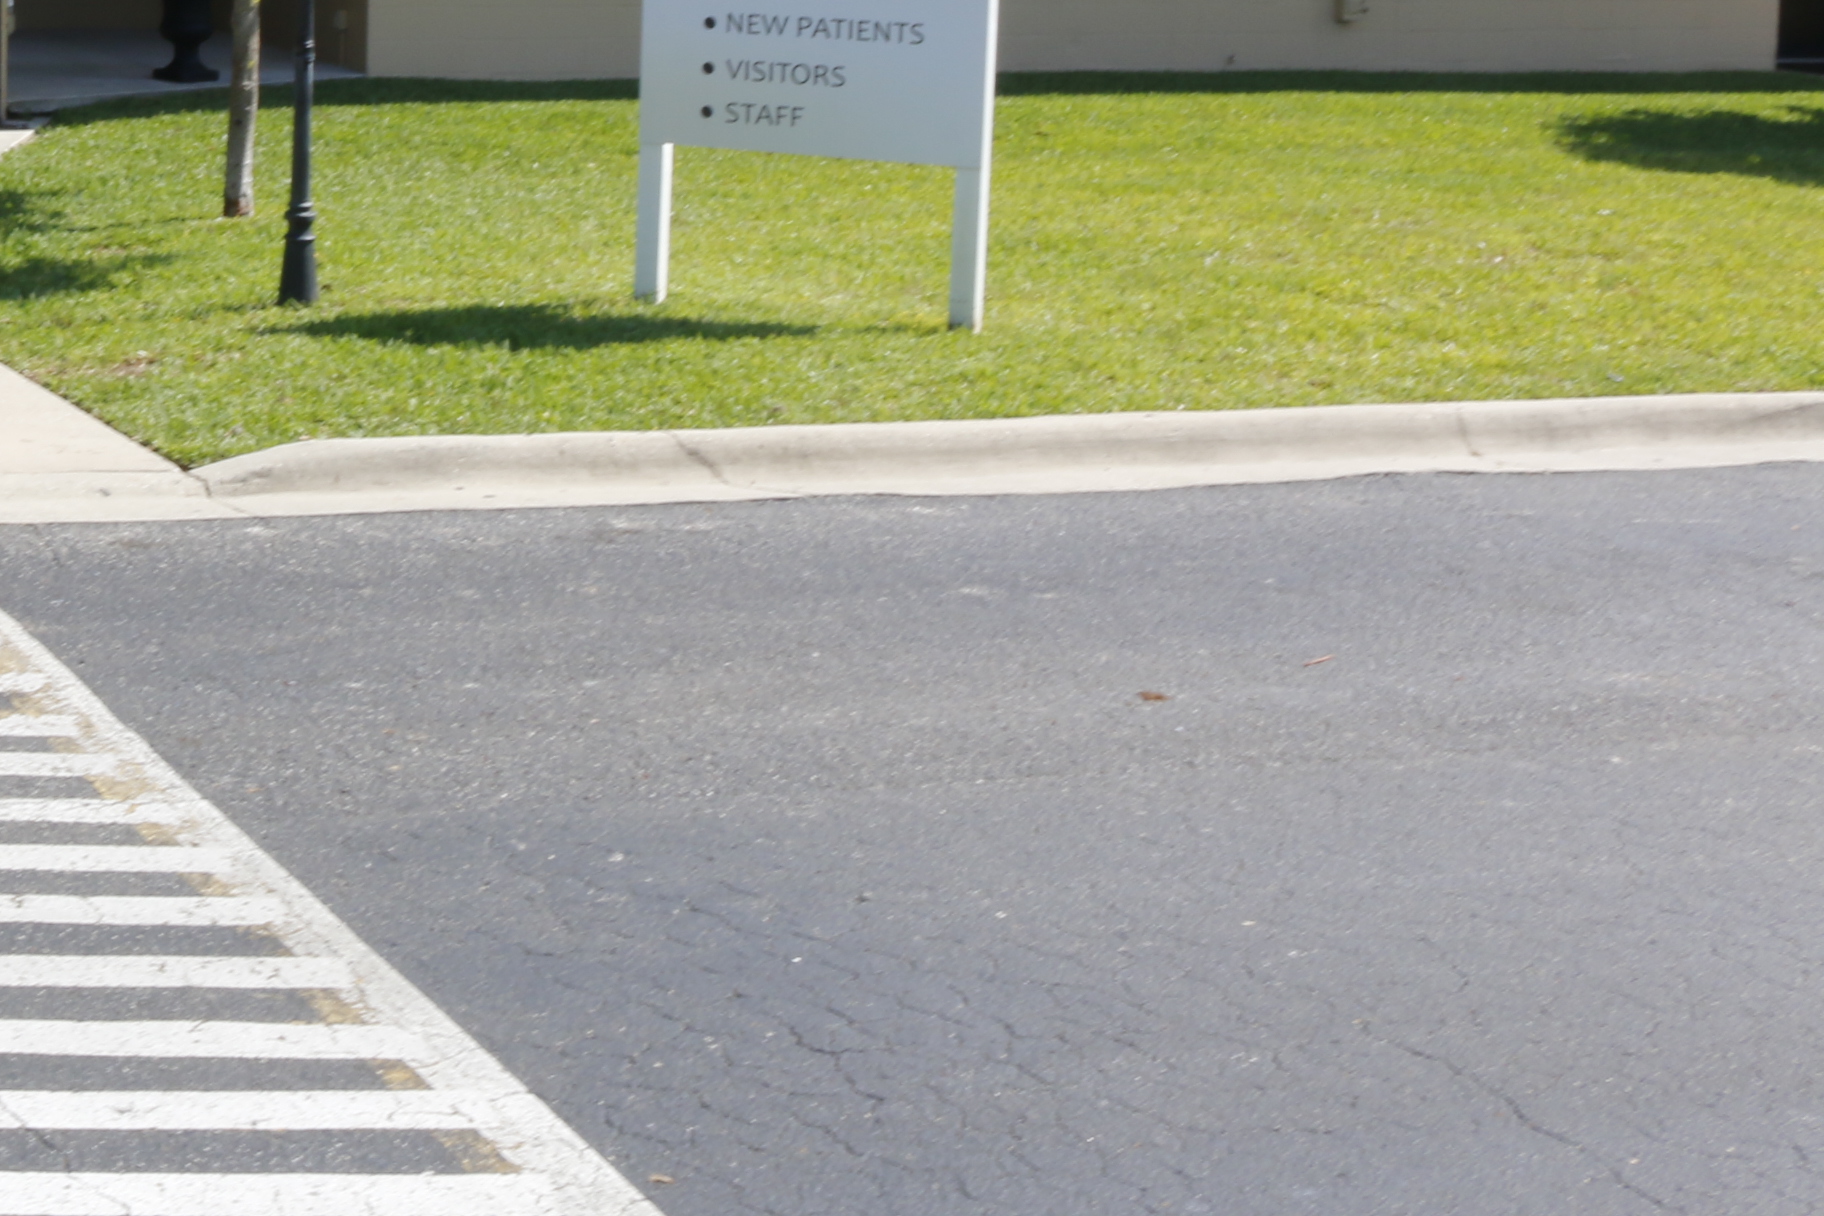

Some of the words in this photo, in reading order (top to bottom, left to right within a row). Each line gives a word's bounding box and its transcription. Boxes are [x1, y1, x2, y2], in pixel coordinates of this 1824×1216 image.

[725, 12, 790, 37] NEW
[797, 16, 926, 45] PATIENTS
[724, 58, 847, 88] VISITORS
[724, 102, 806, 127] STAFF
